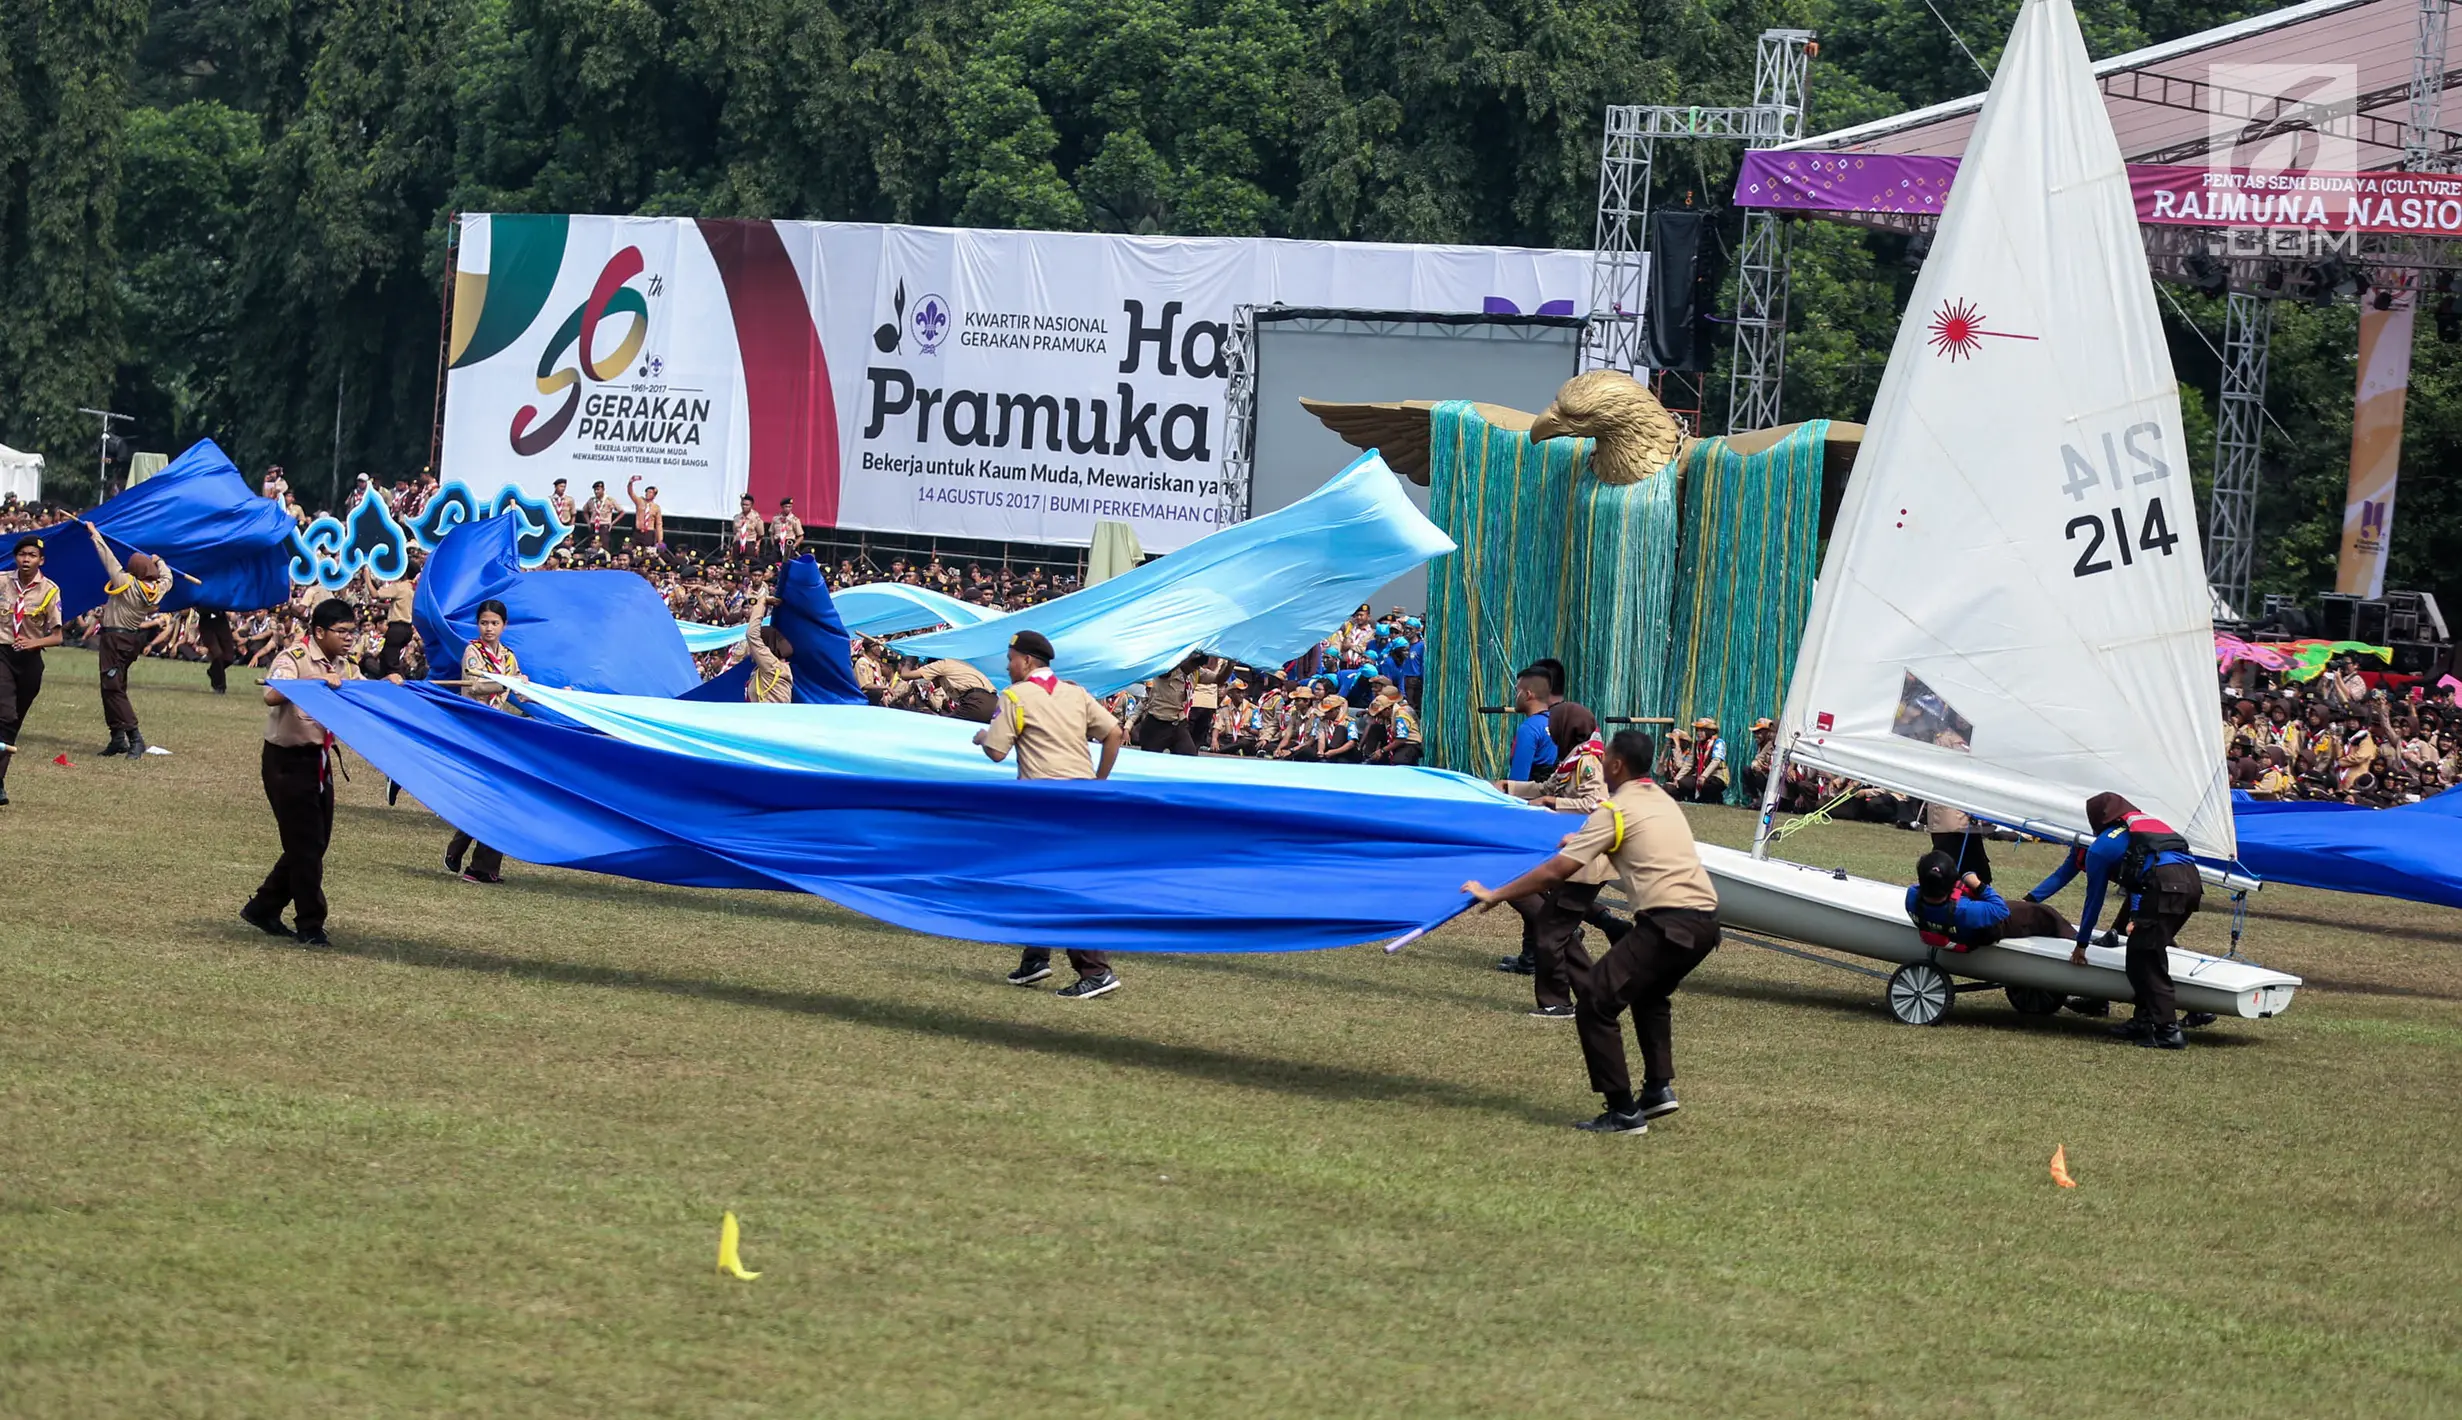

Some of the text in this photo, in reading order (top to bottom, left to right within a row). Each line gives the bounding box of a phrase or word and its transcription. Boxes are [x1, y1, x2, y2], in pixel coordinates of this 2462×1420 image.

[2202, 173, 2461, 196] PENTAS SENI BUDAYA (CULTURE
[2152, 190, 2462, 230] RAIMUNA NASIO
[965, 311, 1108, 334] KWARTIR NASIONAL
[960, 331, 1107, 354] GERAKAN PRAMUKA
[1119, 299, 1246, 379] Ha
[631, 383, 667, 393] 1961-2017
[585, 393, 710, 422] GERAKAN
[863, 366, 1210, 462] Pramuka
[577, 417, 700, 446] PRAMUKA
[572, 452, 709, 468] MEWARISKAN YANG TERBAIK BAGI BANGSA
[594, 443, 688, 456] BEKERJA UNTUK KAUM MUDA
[862, 451, 923, 477] Bekerja
[926, 457, 976, 477] untuk
[979, 459, 1026, 481] Kaum
[1030, 463, 1083, 488] Muda,
[1087, 466, 1194, 493] Mewariskan
[918, 486, 935, 502] 14
[937, 487, 1003, 507] AGUSTUS
[1006, 492, 1040, 510] 2017
[1050, 495, 1090, 514] BUMI
[1093, 499, 1200, 522] PERKEMAHAN
[2064, 496, 2179, 578] 214
